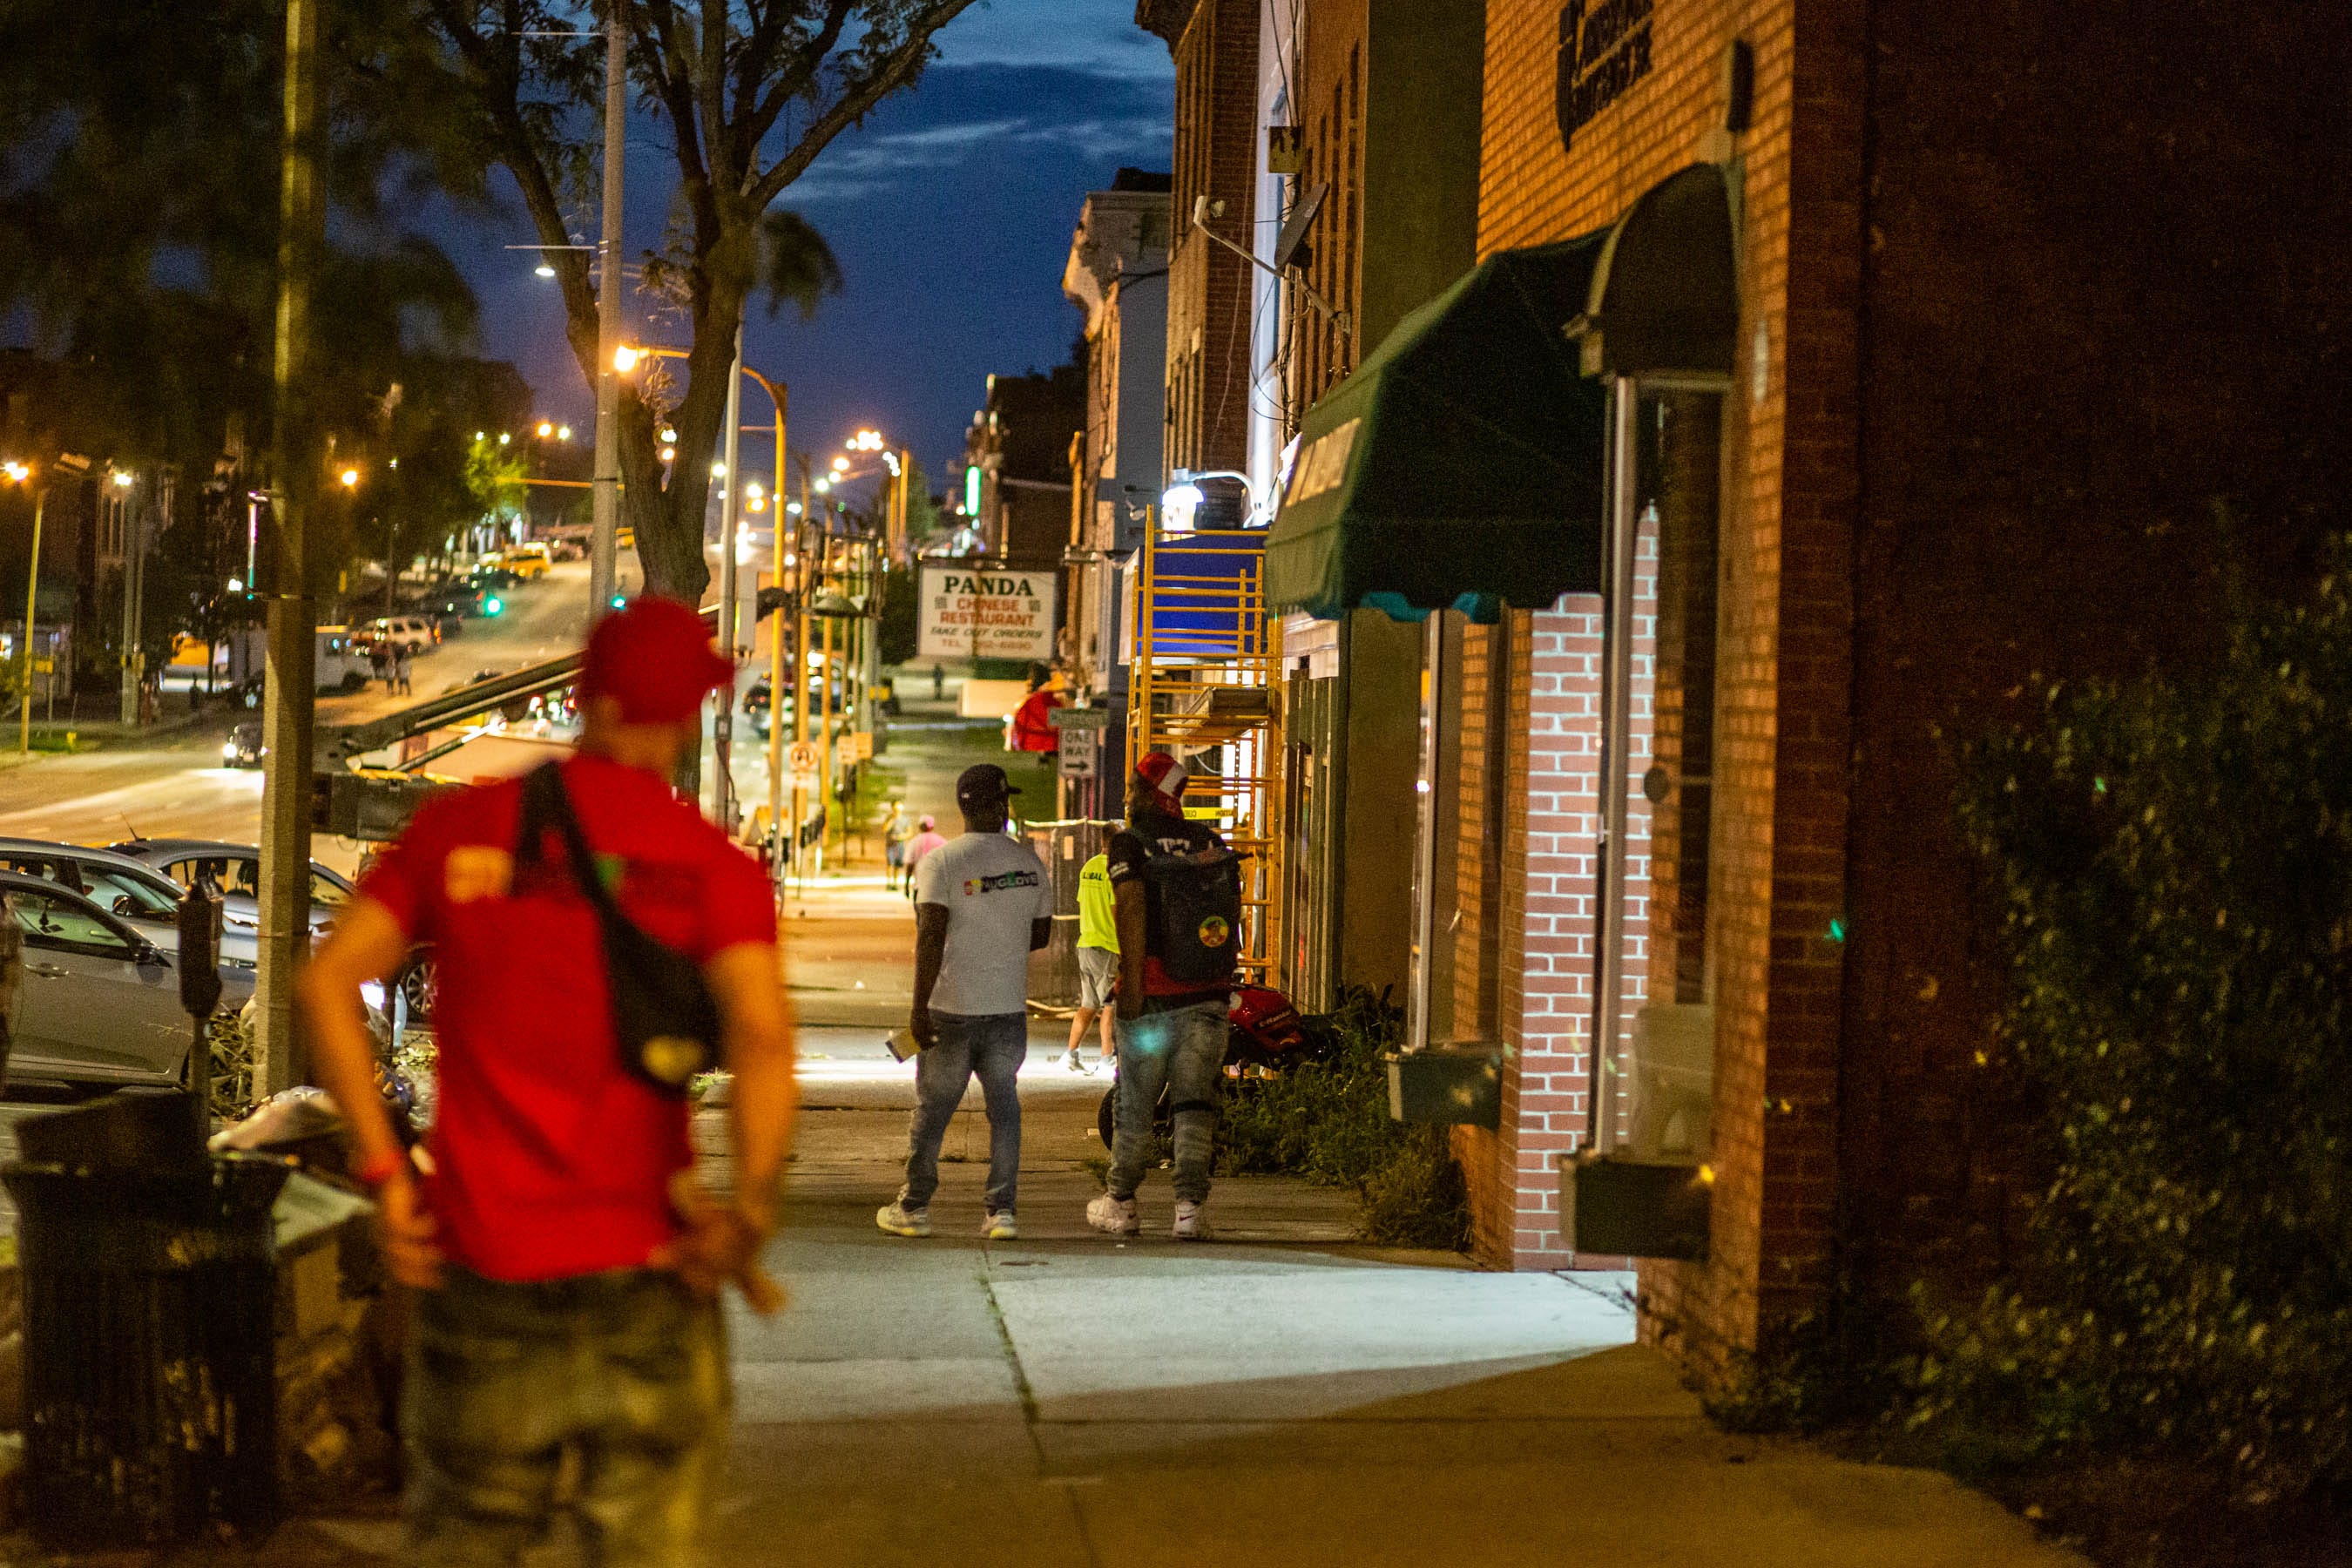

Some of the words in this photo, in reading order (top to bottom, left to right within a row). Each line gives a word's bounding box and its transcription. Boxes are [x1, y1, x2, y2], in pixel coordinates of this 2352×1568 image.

[944, 576, 1033, 596] PANDA
[956, 597, 1019, 612] CHINESE
[940, 612, 1035, 627] RESTAURANT
[930, 626, 957, 636] TAKE
[963, 627, 990, 638] OUT
